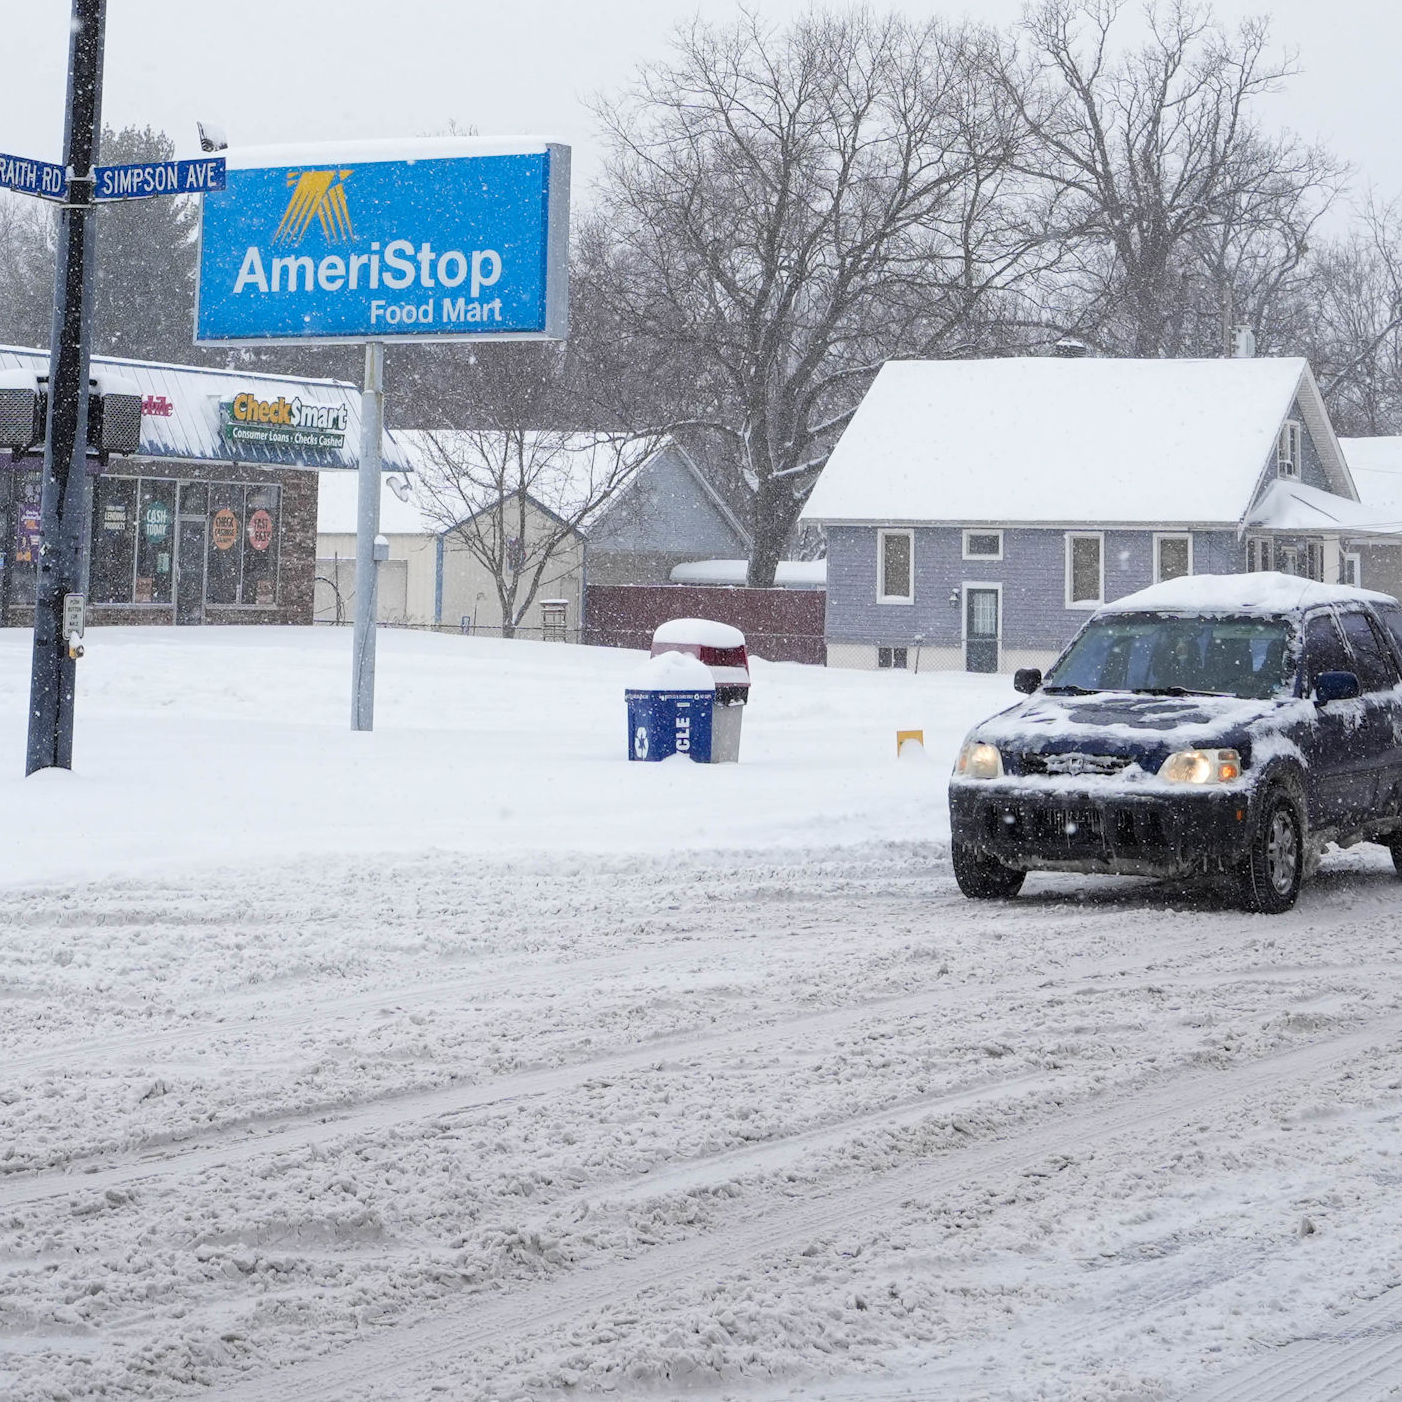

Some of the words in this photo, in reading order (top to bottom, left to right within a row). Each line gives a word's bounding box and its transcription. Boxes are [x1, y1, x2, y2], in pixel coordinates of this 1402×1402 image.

[42, 166, 62, 193] RD
[103, 165, 184, 195] SIMPSON
[186, 162, 217, 188] AVE
[233, 239, 502, 297] AmeriStop
[370, 299, 434, 324] Food
[442, 297, 503, 323] Mart
[233, 427, 268, 441] Consumer
[269, 430, 290, 443] Loans
[294, 431, 318, 445] Checks
[319, 434, 344, 448] Cashed
[146, 524, 166, 536] TODAY
[147, 509, 167, 524] CASH
